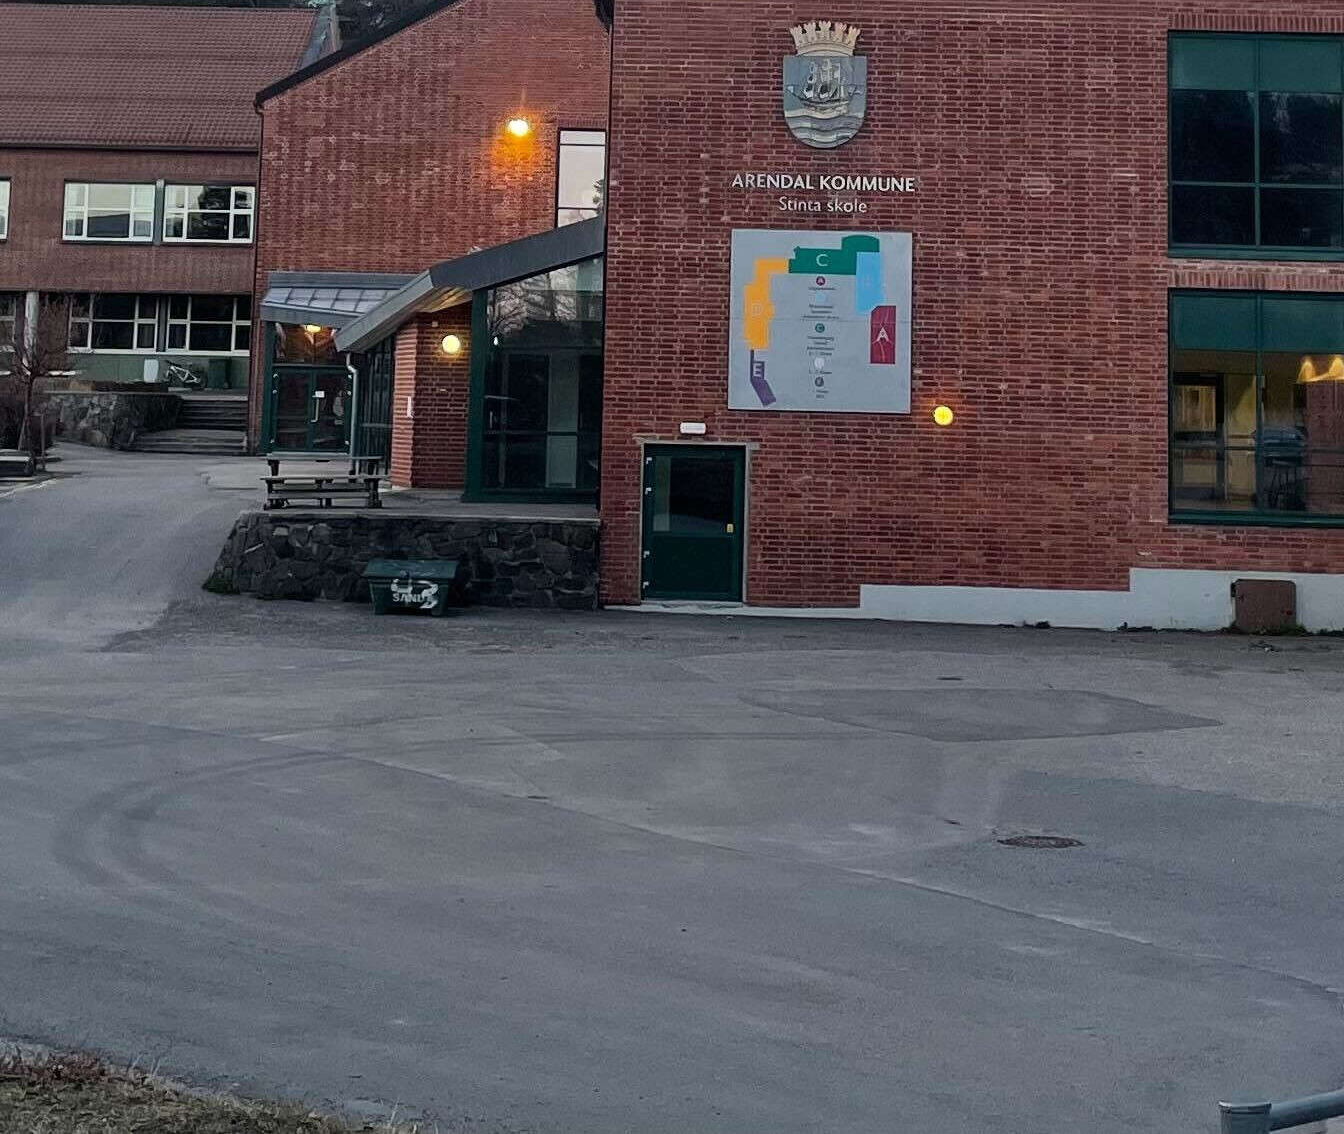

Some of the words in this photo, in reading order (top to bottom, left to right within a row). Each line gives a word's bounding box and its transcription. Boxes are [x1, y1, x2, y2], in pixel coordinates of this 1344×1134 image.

[731, 173, 815, 190] ARENDAL
[819, 175, 916, 192] KOMMUNE
[779, 196, 821, 212] Stinta
[826, 197, 868, 213] skole
[816, 253, 829, 267] C
